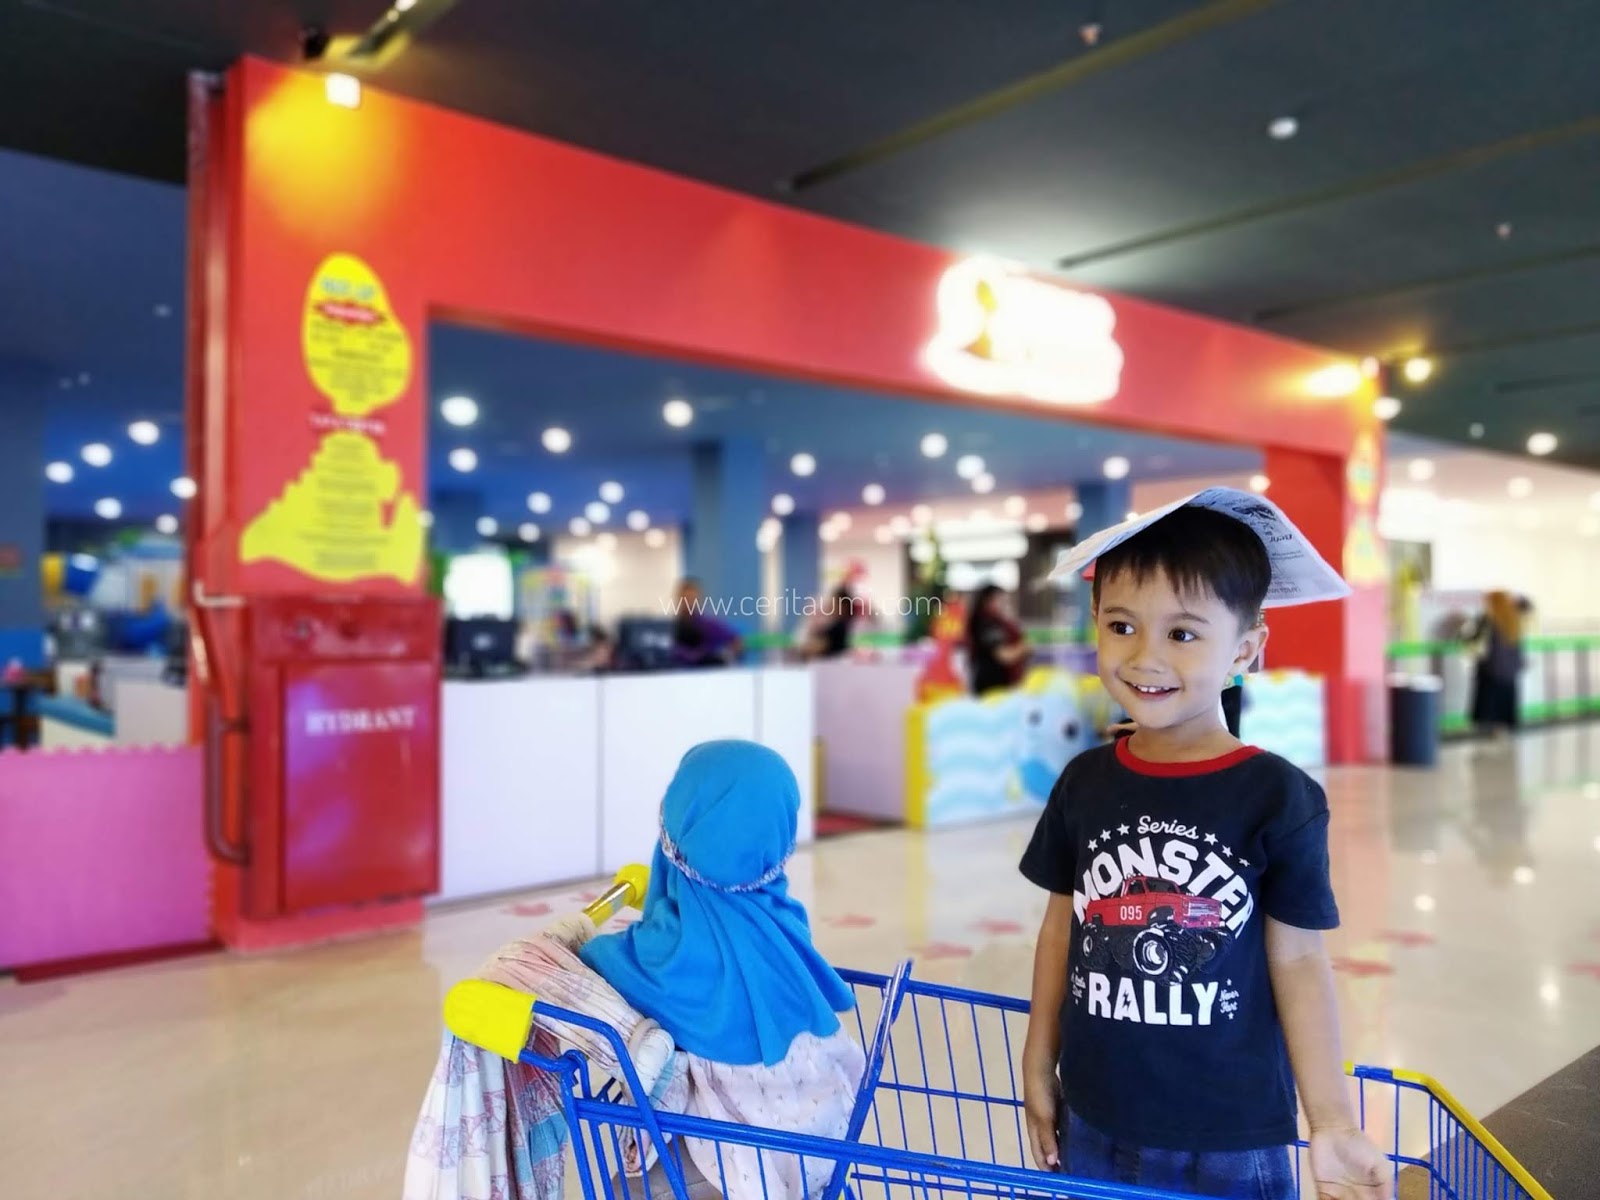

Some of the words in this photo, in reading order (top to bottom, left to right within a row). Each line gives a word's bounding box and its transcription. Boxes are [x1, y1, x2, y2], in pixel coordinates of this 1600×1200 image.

[1137, 815, 1199, 840] Series
[1120, 905, 1143, 921] 095
[1088, 972, 1219, 1026] RALLY
